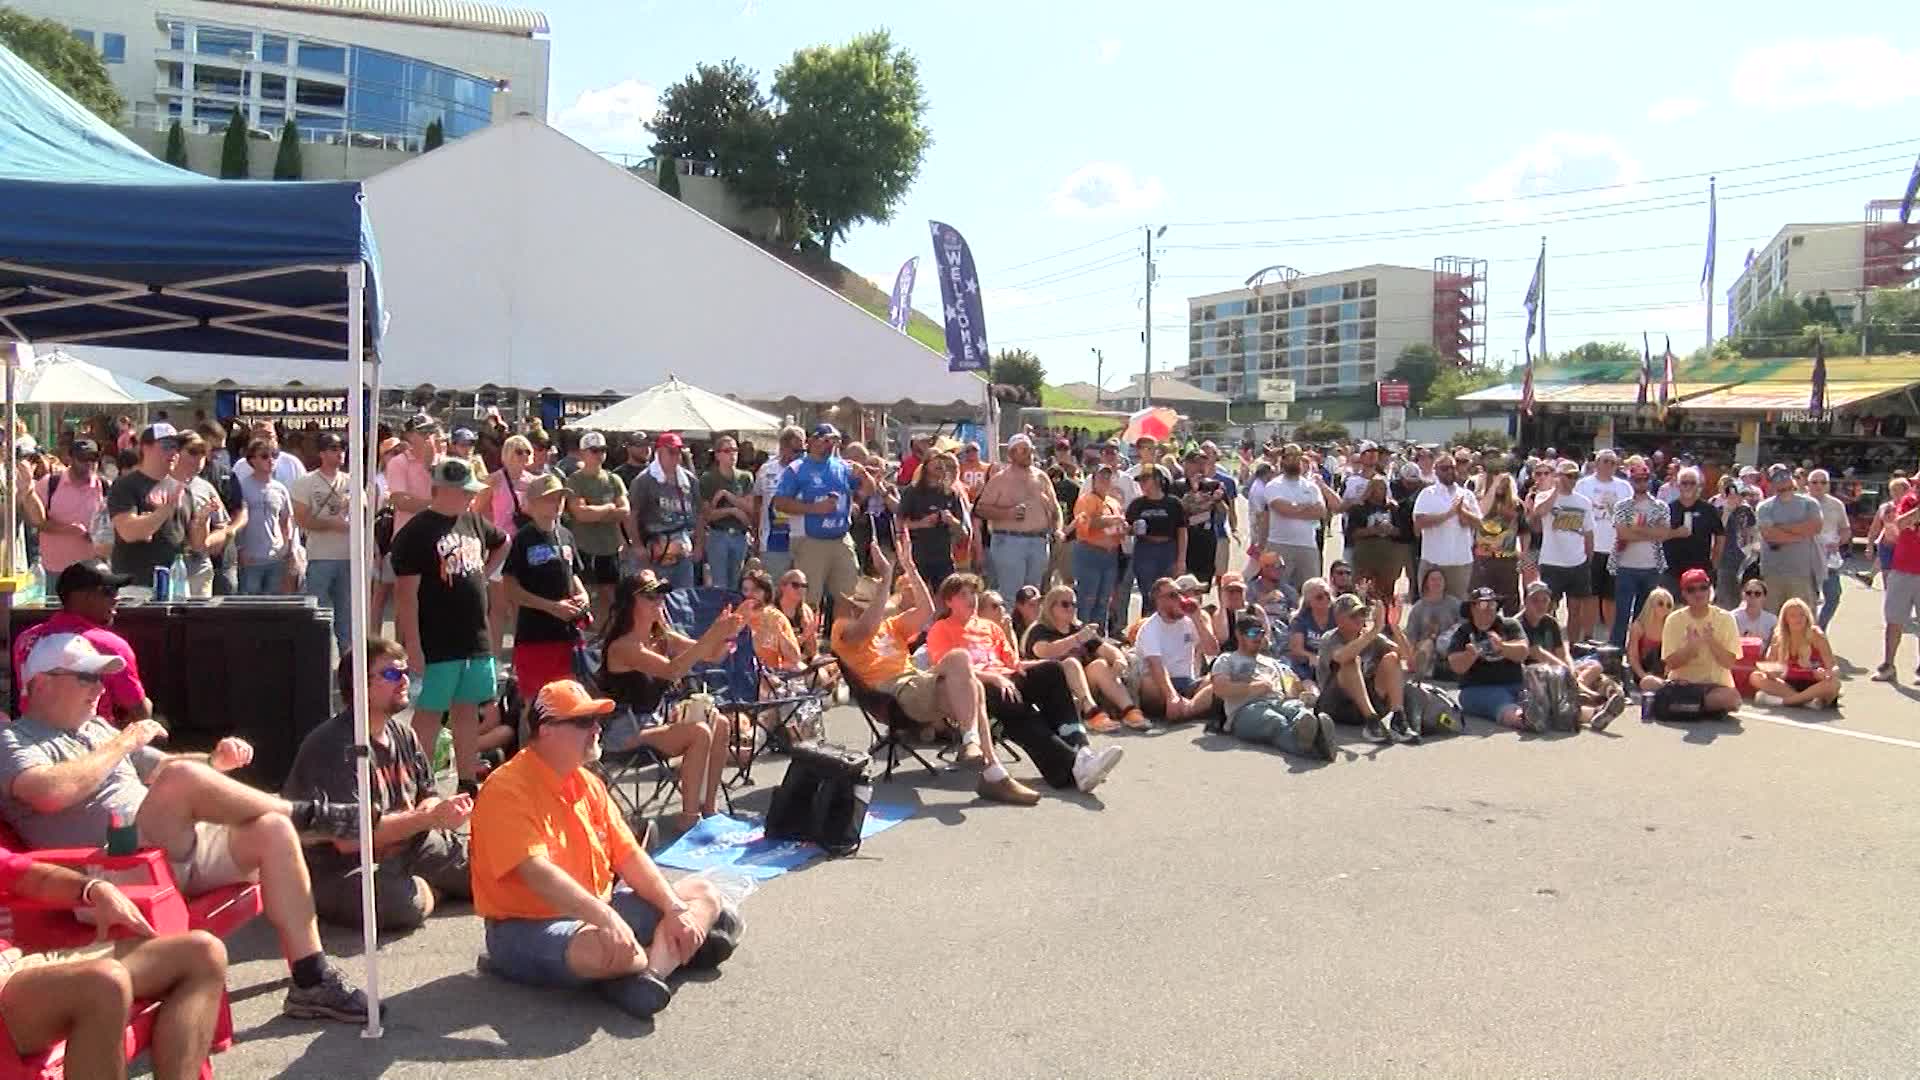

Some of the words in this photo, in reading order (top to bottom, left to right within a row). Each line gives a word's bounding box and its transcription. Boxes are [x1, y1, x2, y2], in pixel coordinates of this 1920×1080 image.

[945, 251, 974, 360] WELCOME
[240, 397, 285, 412] BUD
[286, 397, 345, 412] LIGHT
